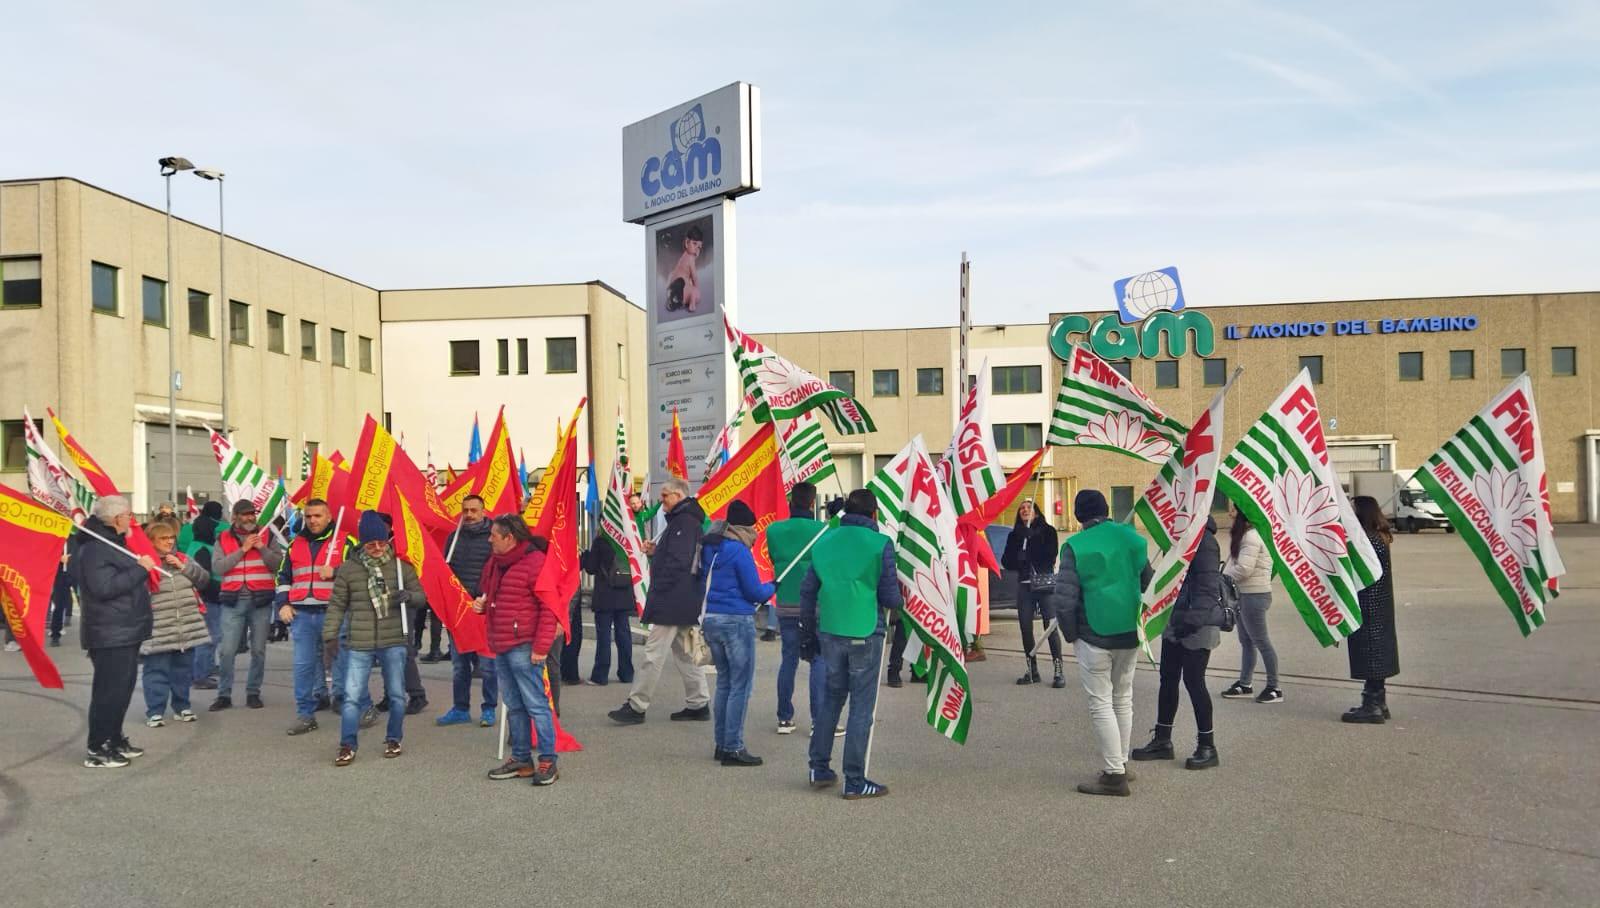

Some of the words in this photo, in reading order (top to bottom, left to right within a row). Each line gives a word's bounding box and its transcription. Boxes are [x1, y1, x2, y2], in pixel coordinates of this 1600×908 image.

[641, 137, 721, 196] cam
[651, 193, 676, 207] MONDO
[677, 189, 688, 199] DEL
[689, 178, 722, 195] BAMBINO
[1050, 310, 1215, 361] cam
[1225, 325, 1242, 339] IL
[1250, 321, 1329, 338] MONDO
[1335, 319, 1372, 335] DEL
[1380, 314, 1479, 334] BAMBINO
[1330, 418, 1337, 430] 2
[1432, 462, 1508, 558] METALMECCANICI
[1294, 560, 1344, 626] BERGAMO
